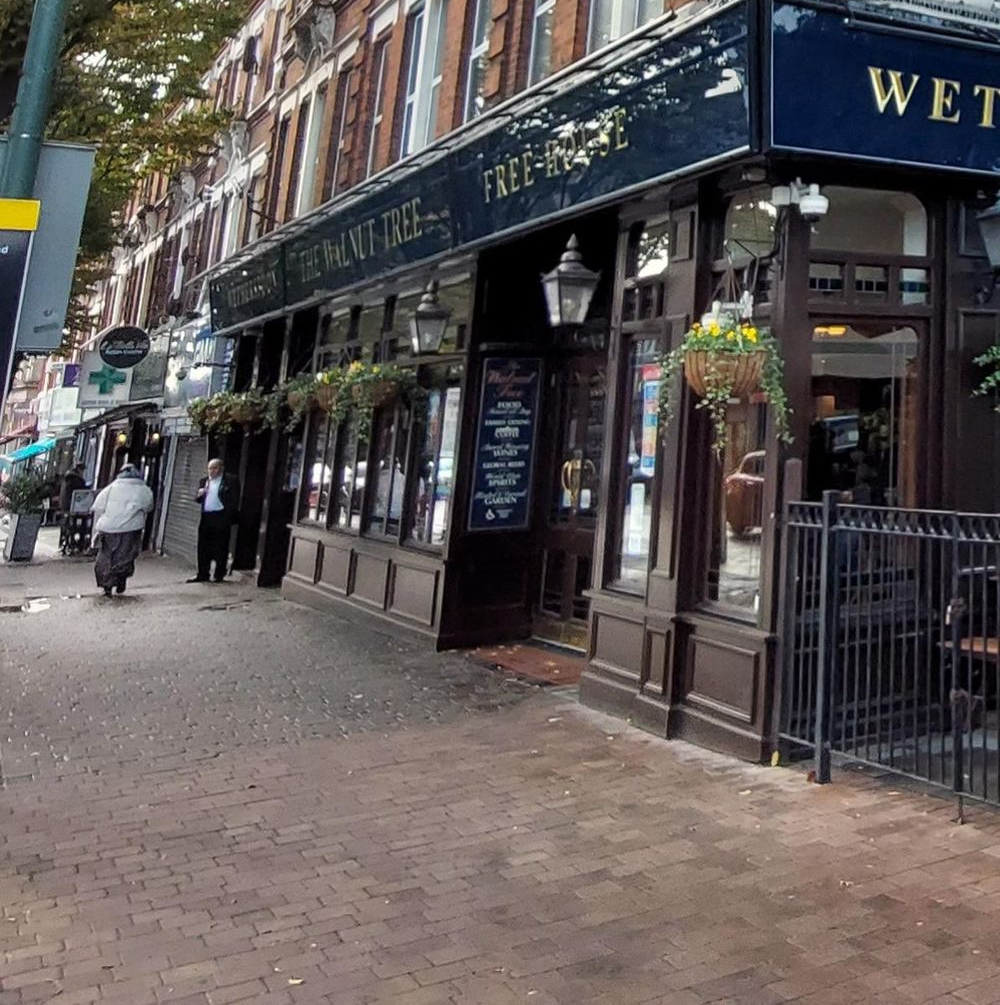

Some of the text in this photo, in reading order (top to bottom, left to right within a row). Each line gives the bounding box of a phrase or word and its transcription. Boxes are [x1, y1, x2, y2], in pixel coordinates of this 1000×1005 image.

[482, 106, 629, 204] FREE HOUSE
[298, 197, 424, 283] THE WALNUT TREE
[484, 496, 518, 505] GARDEN
